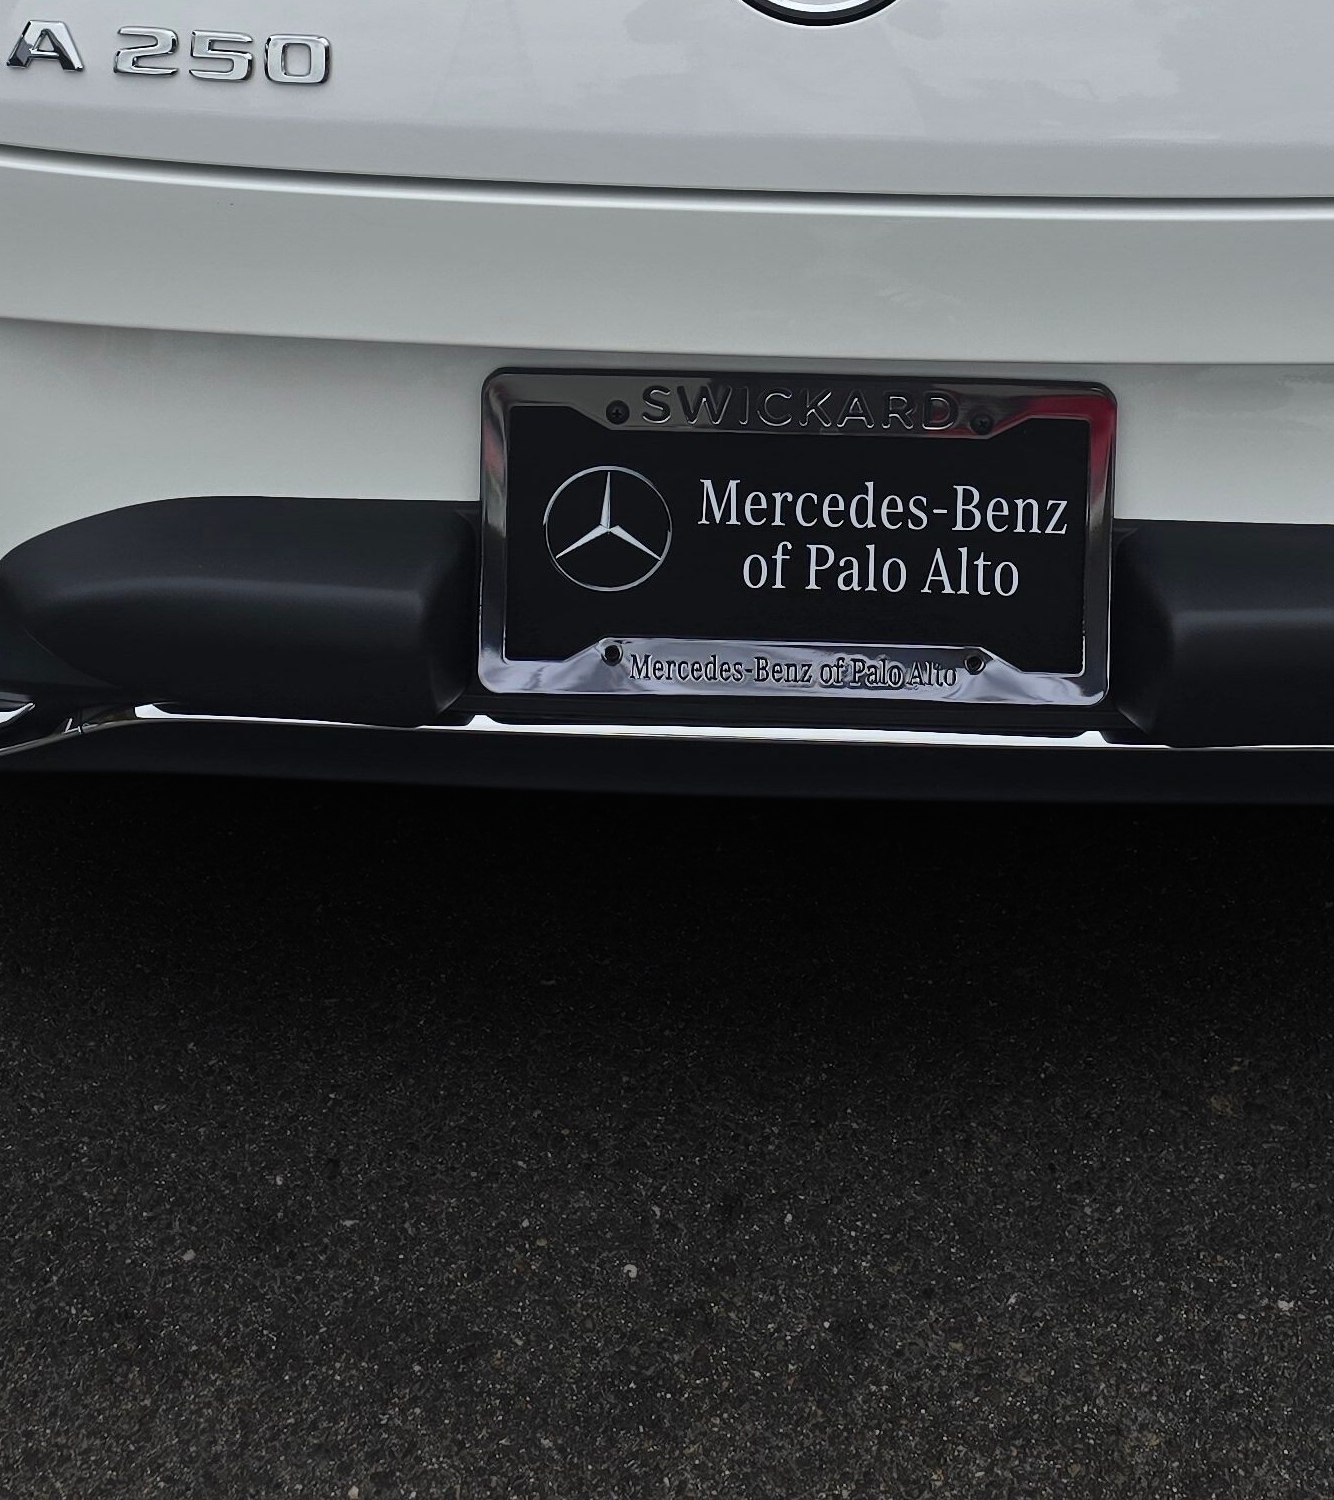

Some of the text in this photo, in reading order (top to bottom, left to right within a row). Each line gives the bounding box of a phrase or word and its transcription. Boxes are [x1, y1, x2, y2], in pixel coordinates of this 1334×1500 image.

[112, 25, 334, 85] 250
[641, 384, 961, 432] SWICKARD
[697, 478, 1069, 535] Mercedes-Benz
[742, 541, 1020, 597] of Palo Alto
[629, 653, 958, 688] Mercedes-Benz of Palo Alto
